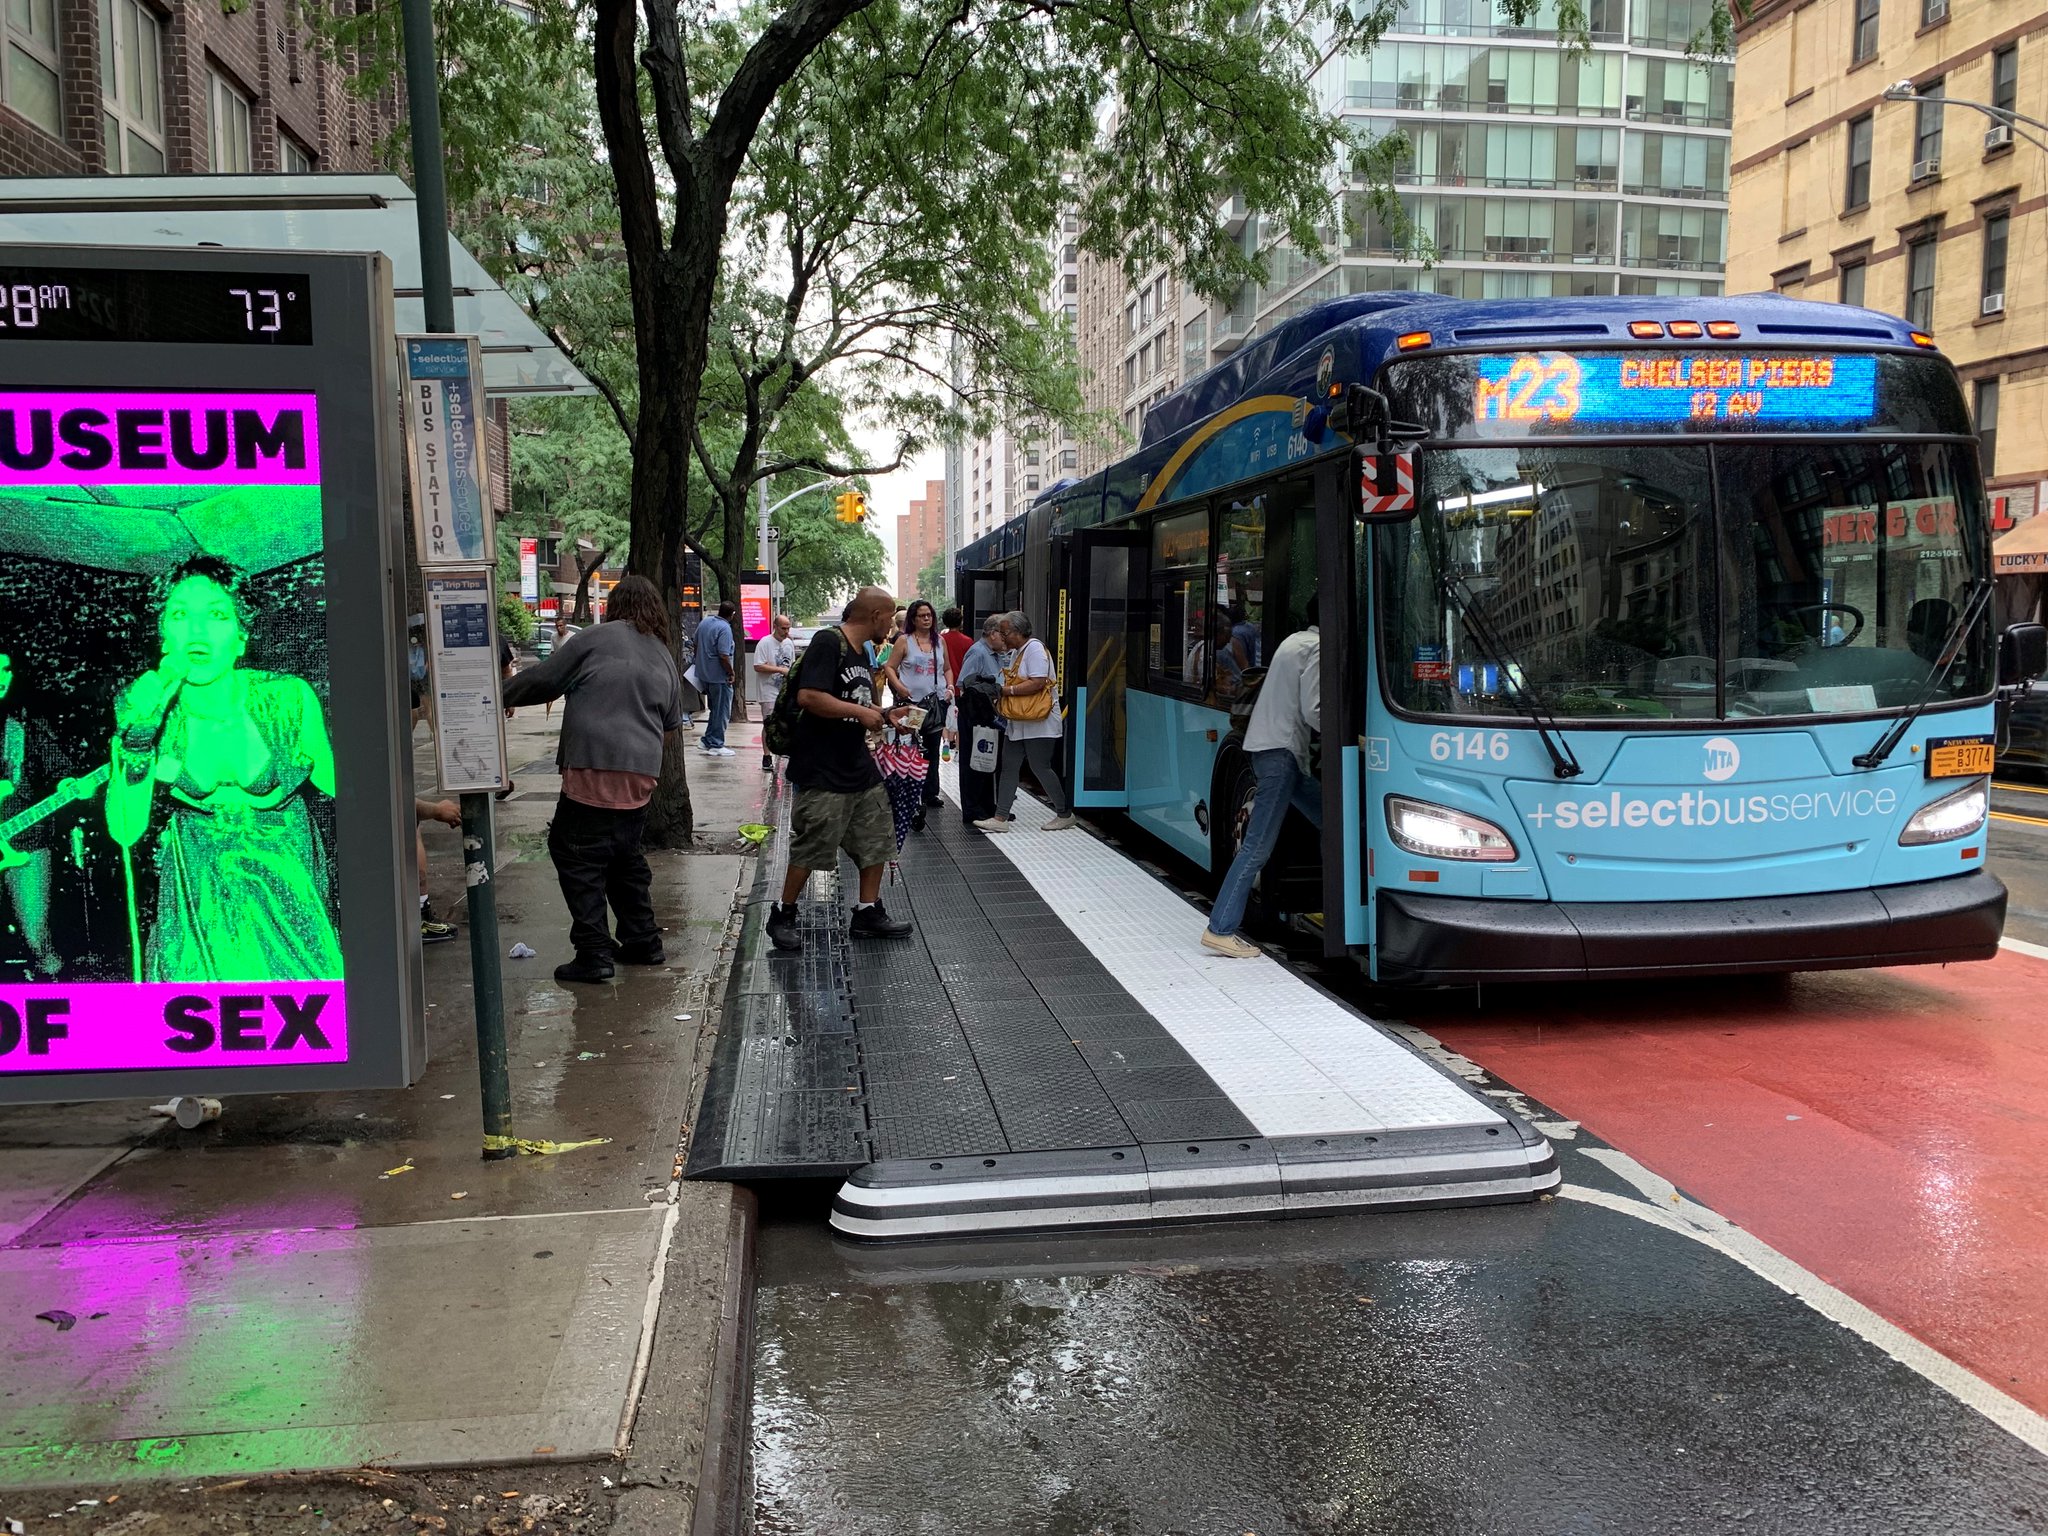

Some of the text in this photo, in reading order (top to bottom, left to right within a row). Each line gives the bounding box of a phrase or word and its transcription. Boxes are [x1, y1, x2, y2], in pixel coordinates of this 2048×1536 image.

[1476, 357, 1834, 420] M23 CHELSEA PIERS
[1691, 391, 1764, 417] 12 AV
[1287, 431, 1308, 460] 6146
[420, 384, 445, 555] BUS STATION
[2000, 555, 2039, 566] LUCKY
[445, 580, 481, 590] Trip Tips
[1430, 732, 1510, 761] 6146
[1703, 749, 1733, 771] MTA
[1526, 787, 1897, 829] +selectbusservice
[162, 994, 333, 1053] SEX
